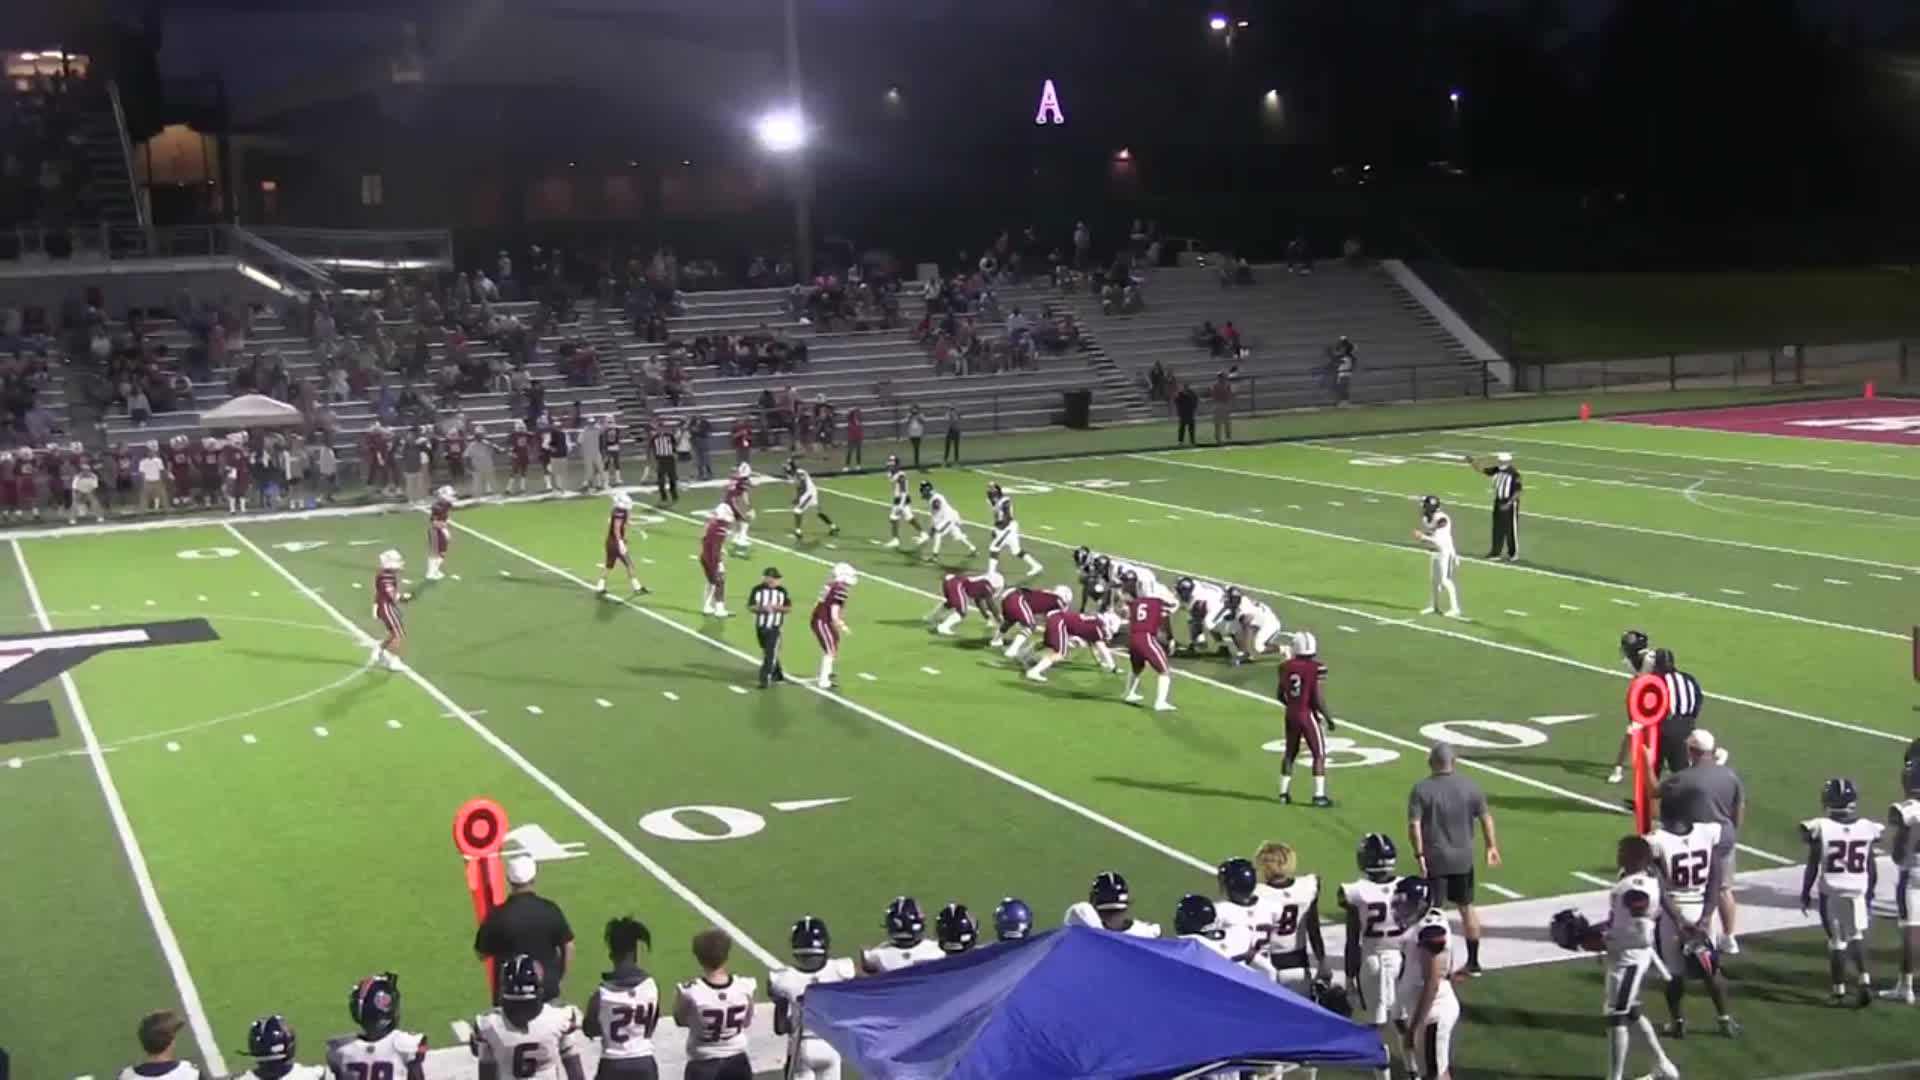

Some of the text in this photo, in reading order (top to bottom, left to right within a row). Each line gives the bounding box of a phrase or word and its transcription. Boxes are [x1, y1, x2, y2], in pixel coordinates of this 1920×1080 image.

[1036, 79, 1064, 124] A
[1137, 603, 1148, 621] 6
[1289, 673, 1301, 698] 3
[1671, 849, 1708, 888] 62
[1826, 840, 1868, 873] 26
[609, 1002, 655, 1043] 24
[702, 1005, 746, 1043] 35
[513, 1042, 542, 1079] 6
